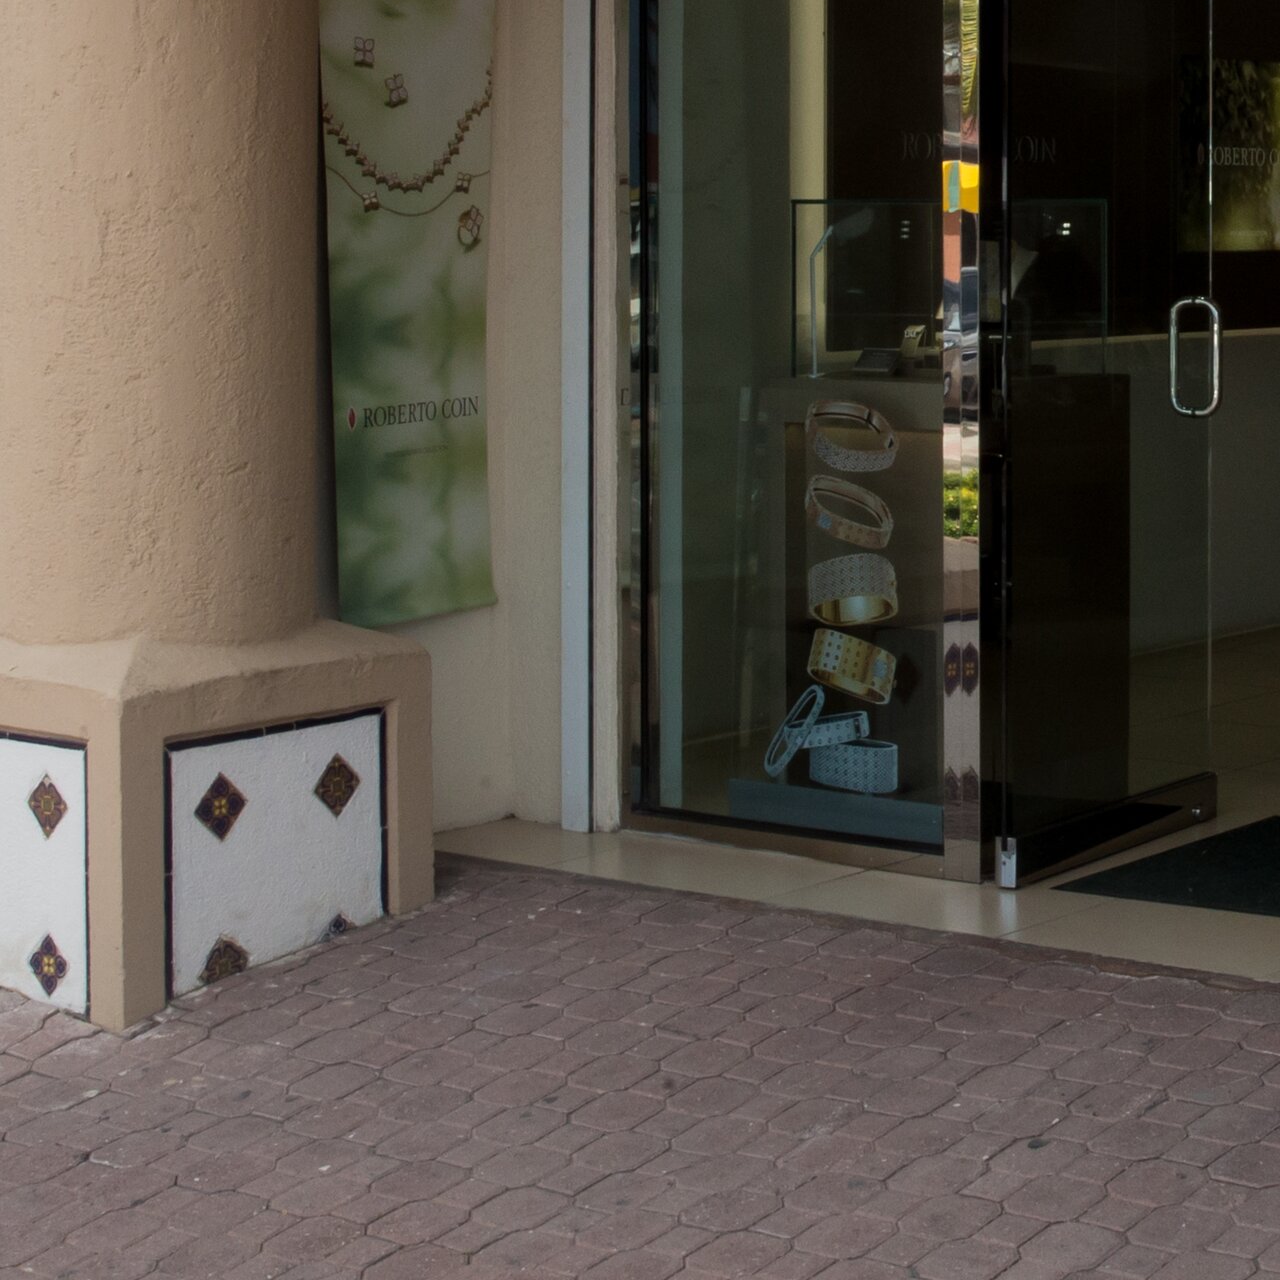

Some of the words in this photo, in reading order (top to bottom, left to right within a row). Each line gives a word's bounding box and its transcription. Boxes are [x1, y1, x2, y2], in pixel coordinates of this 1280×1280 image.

[1209, 147, 1266, 167] OBERTO
[363, 401, 437, 428] ROBERTO
[441, 396, 479, 419] COIN
